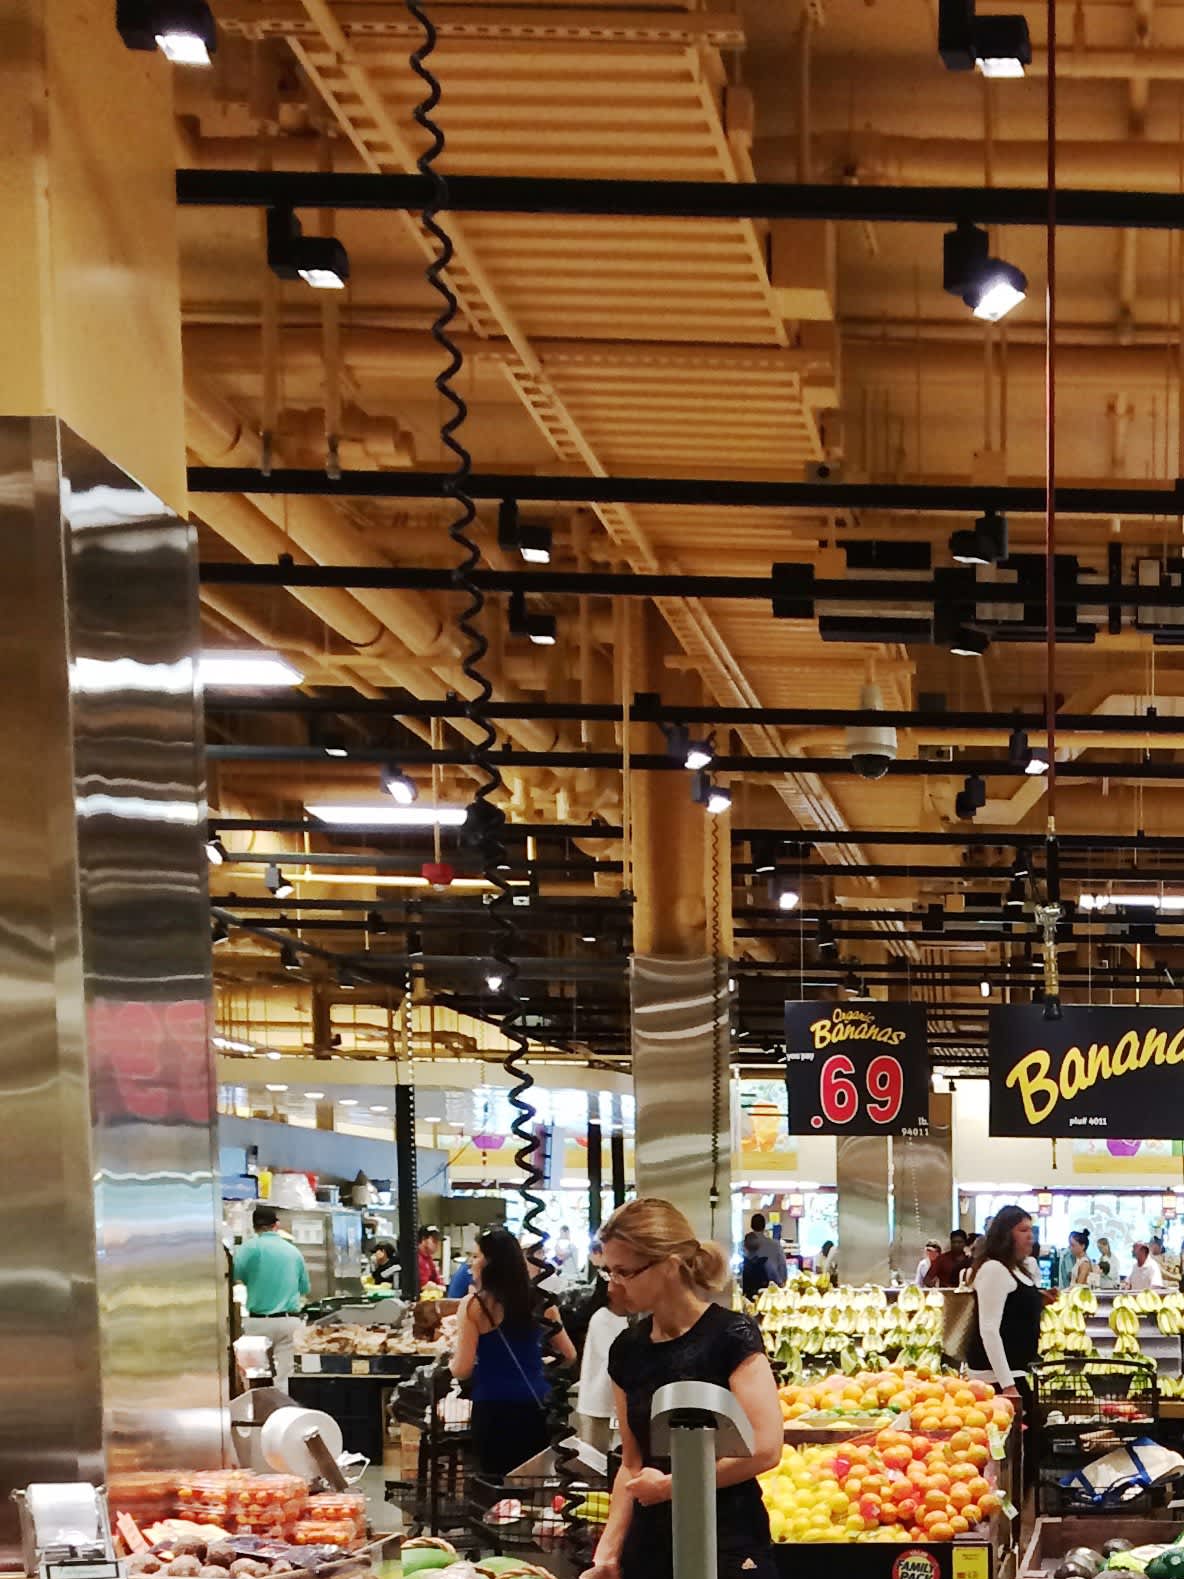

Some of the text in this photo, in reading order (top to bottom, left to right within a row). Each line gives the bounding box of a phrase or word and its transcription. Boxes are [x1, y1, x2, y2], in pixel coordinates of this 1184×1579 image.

[832, 1008, 875, 1023] Organic
[810, 1020, 906, 1049] Bananas
[1088, 1116, 1108, 1126] 4011
[901, 1128, 929, 1137] 94011
[897, 1560, 934, 1573] FAMILY
